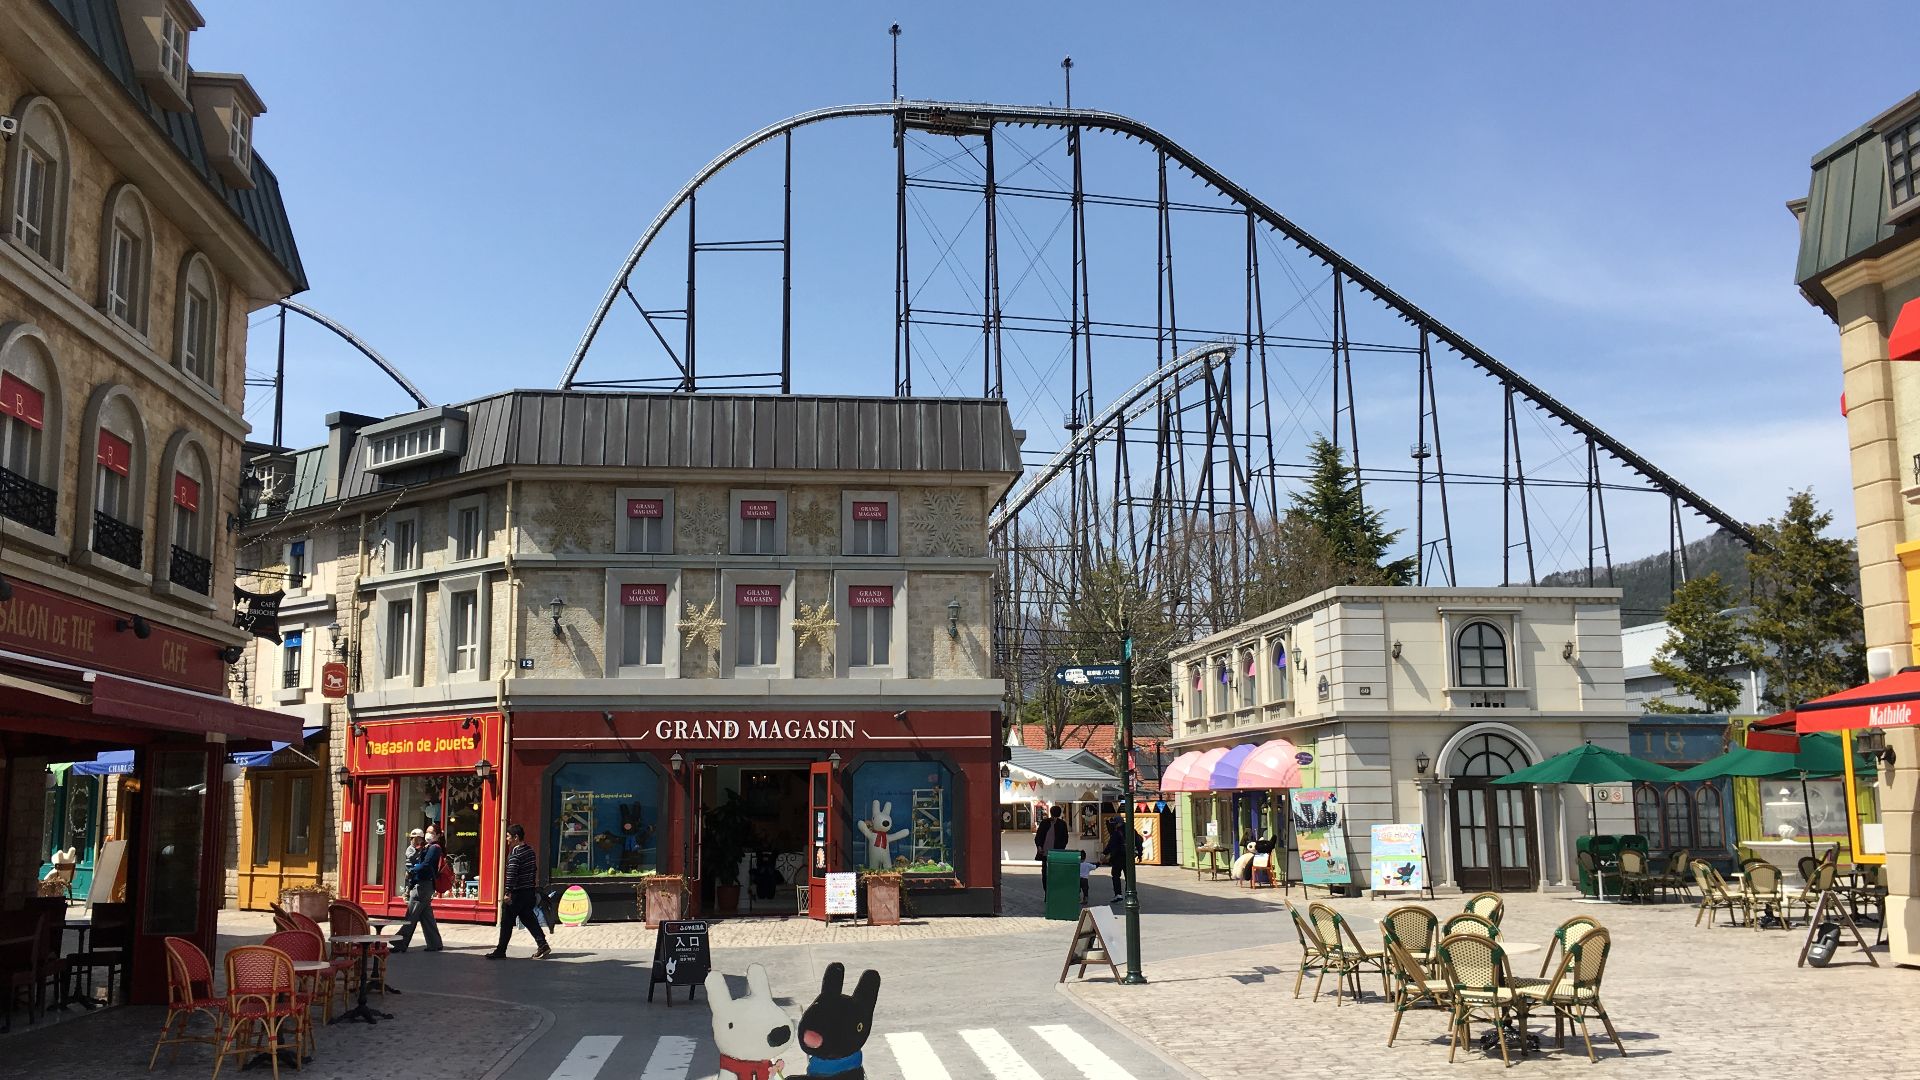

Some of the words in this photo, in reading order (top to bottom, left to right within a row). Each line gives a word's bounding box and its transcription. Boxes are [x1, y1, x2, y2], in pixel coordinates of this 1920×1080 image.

[16, 393, 24, 416] B
[0, 597, 50, 641] SALON
[52, 615, 69, 646] DE
[1869, 703, 1912, 726] Mathilde
[655, 719, 740, 740] GRAND
[747, 719, 856, 740] MAGASIN
[416, 738, 432, 753] de
[433, 735, 475, 753] jouets
[676, 936, 700, 947] 入口
